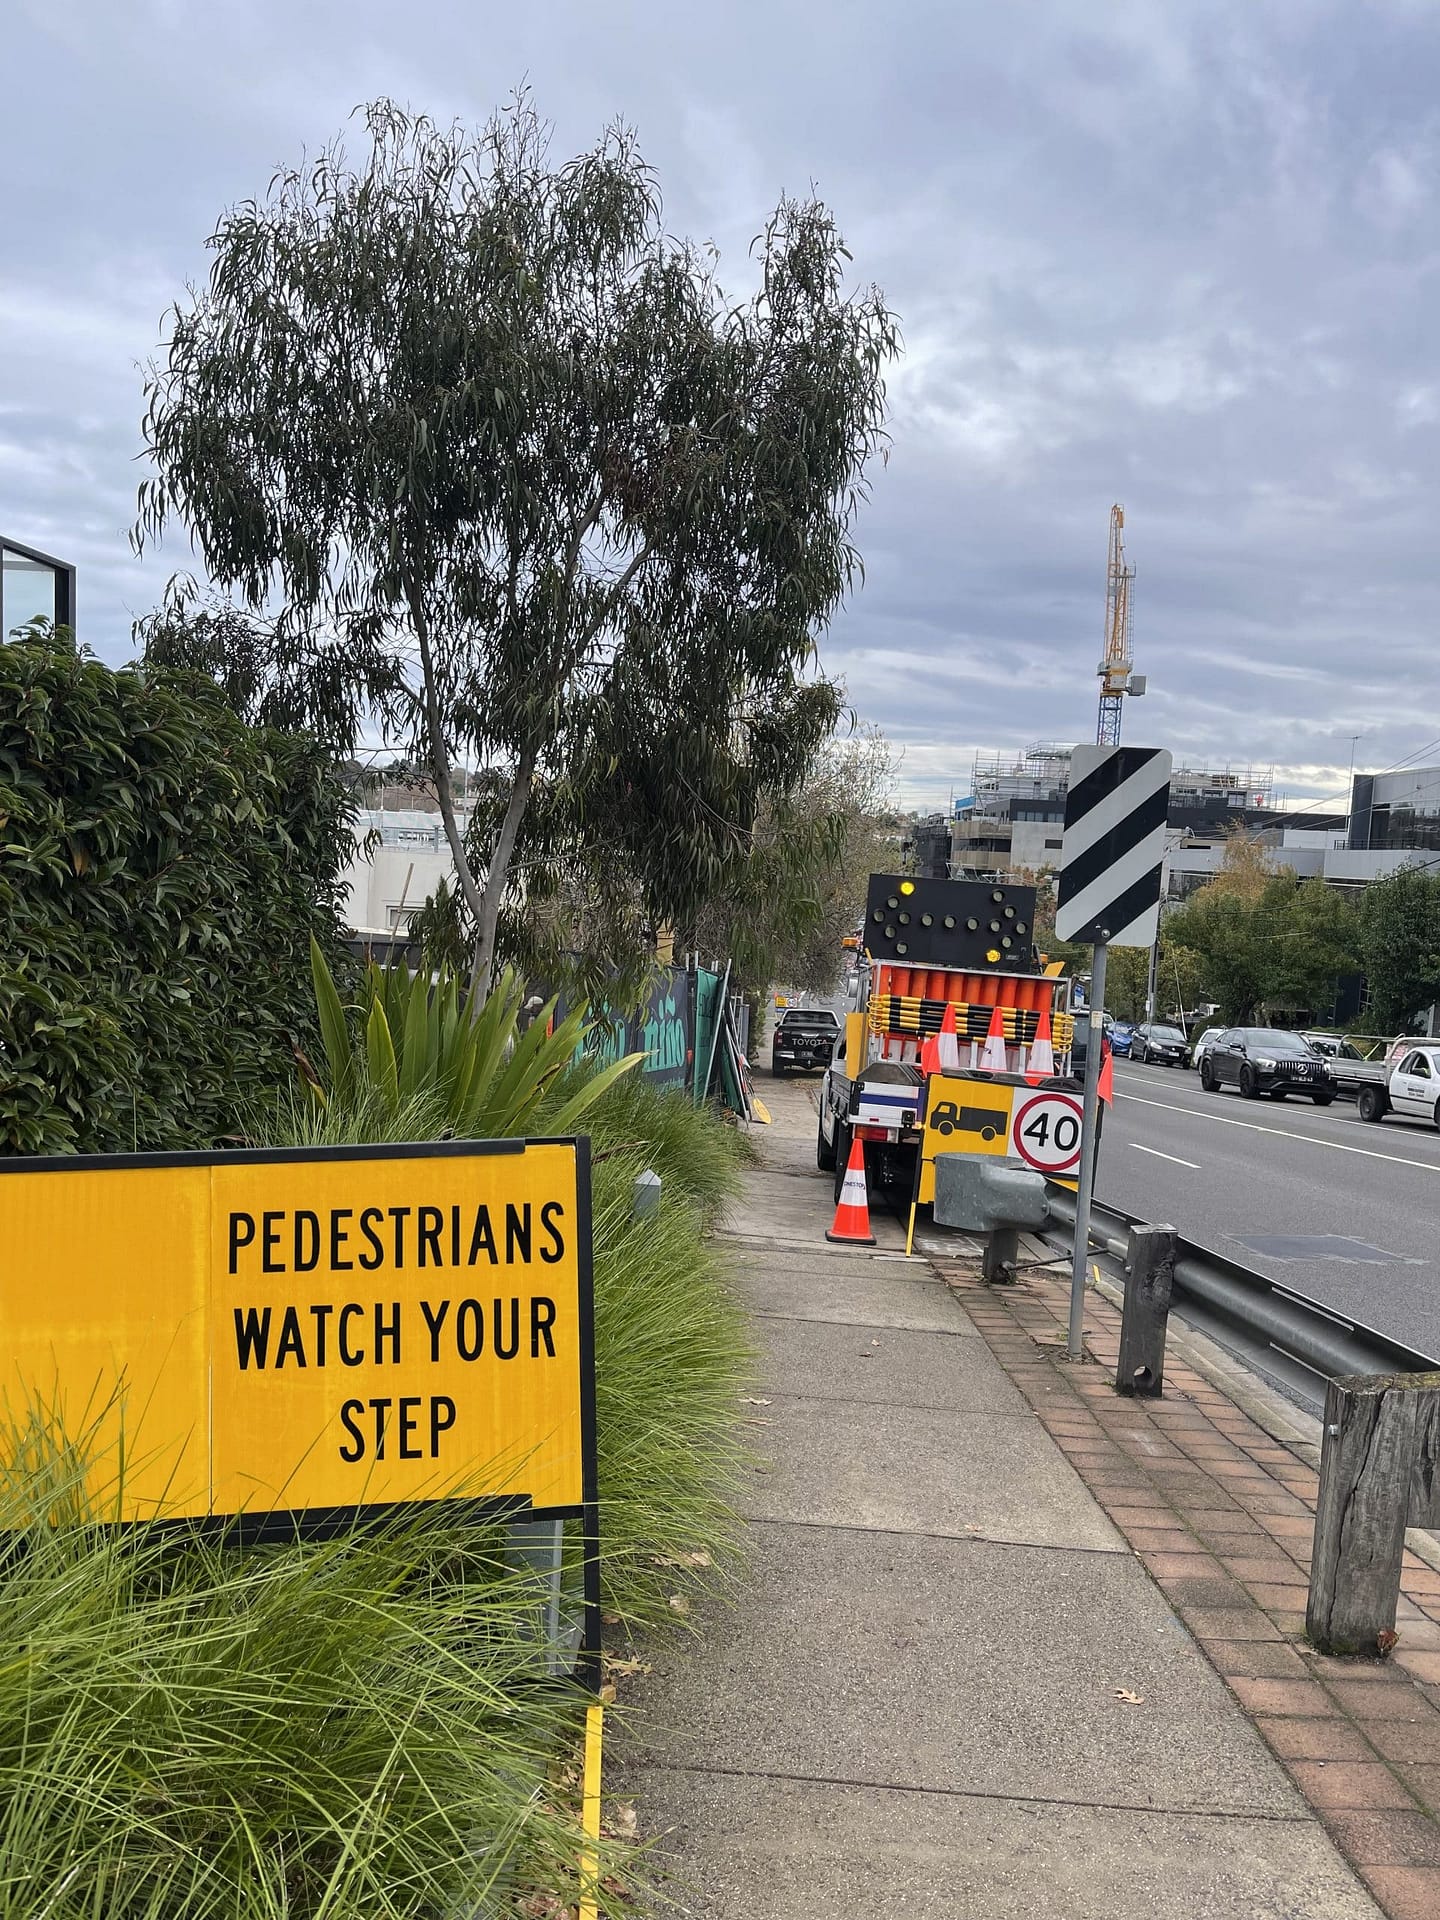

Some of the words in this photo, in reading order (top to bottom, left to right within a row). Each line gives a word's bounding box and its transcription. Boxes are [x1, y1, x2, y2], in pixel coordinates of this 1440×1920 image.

[791, 1038, 827, 1046] TOYOTA
[1024, 1112, 1079, 1151] 40
[228, 1201, 565, 1274] PEDESTRIANS
[234, 1302, 401, 1370] WATCH
[420, 1296, 557, 1362] YOUR
[339, 1396, 456, 1463] STEP
